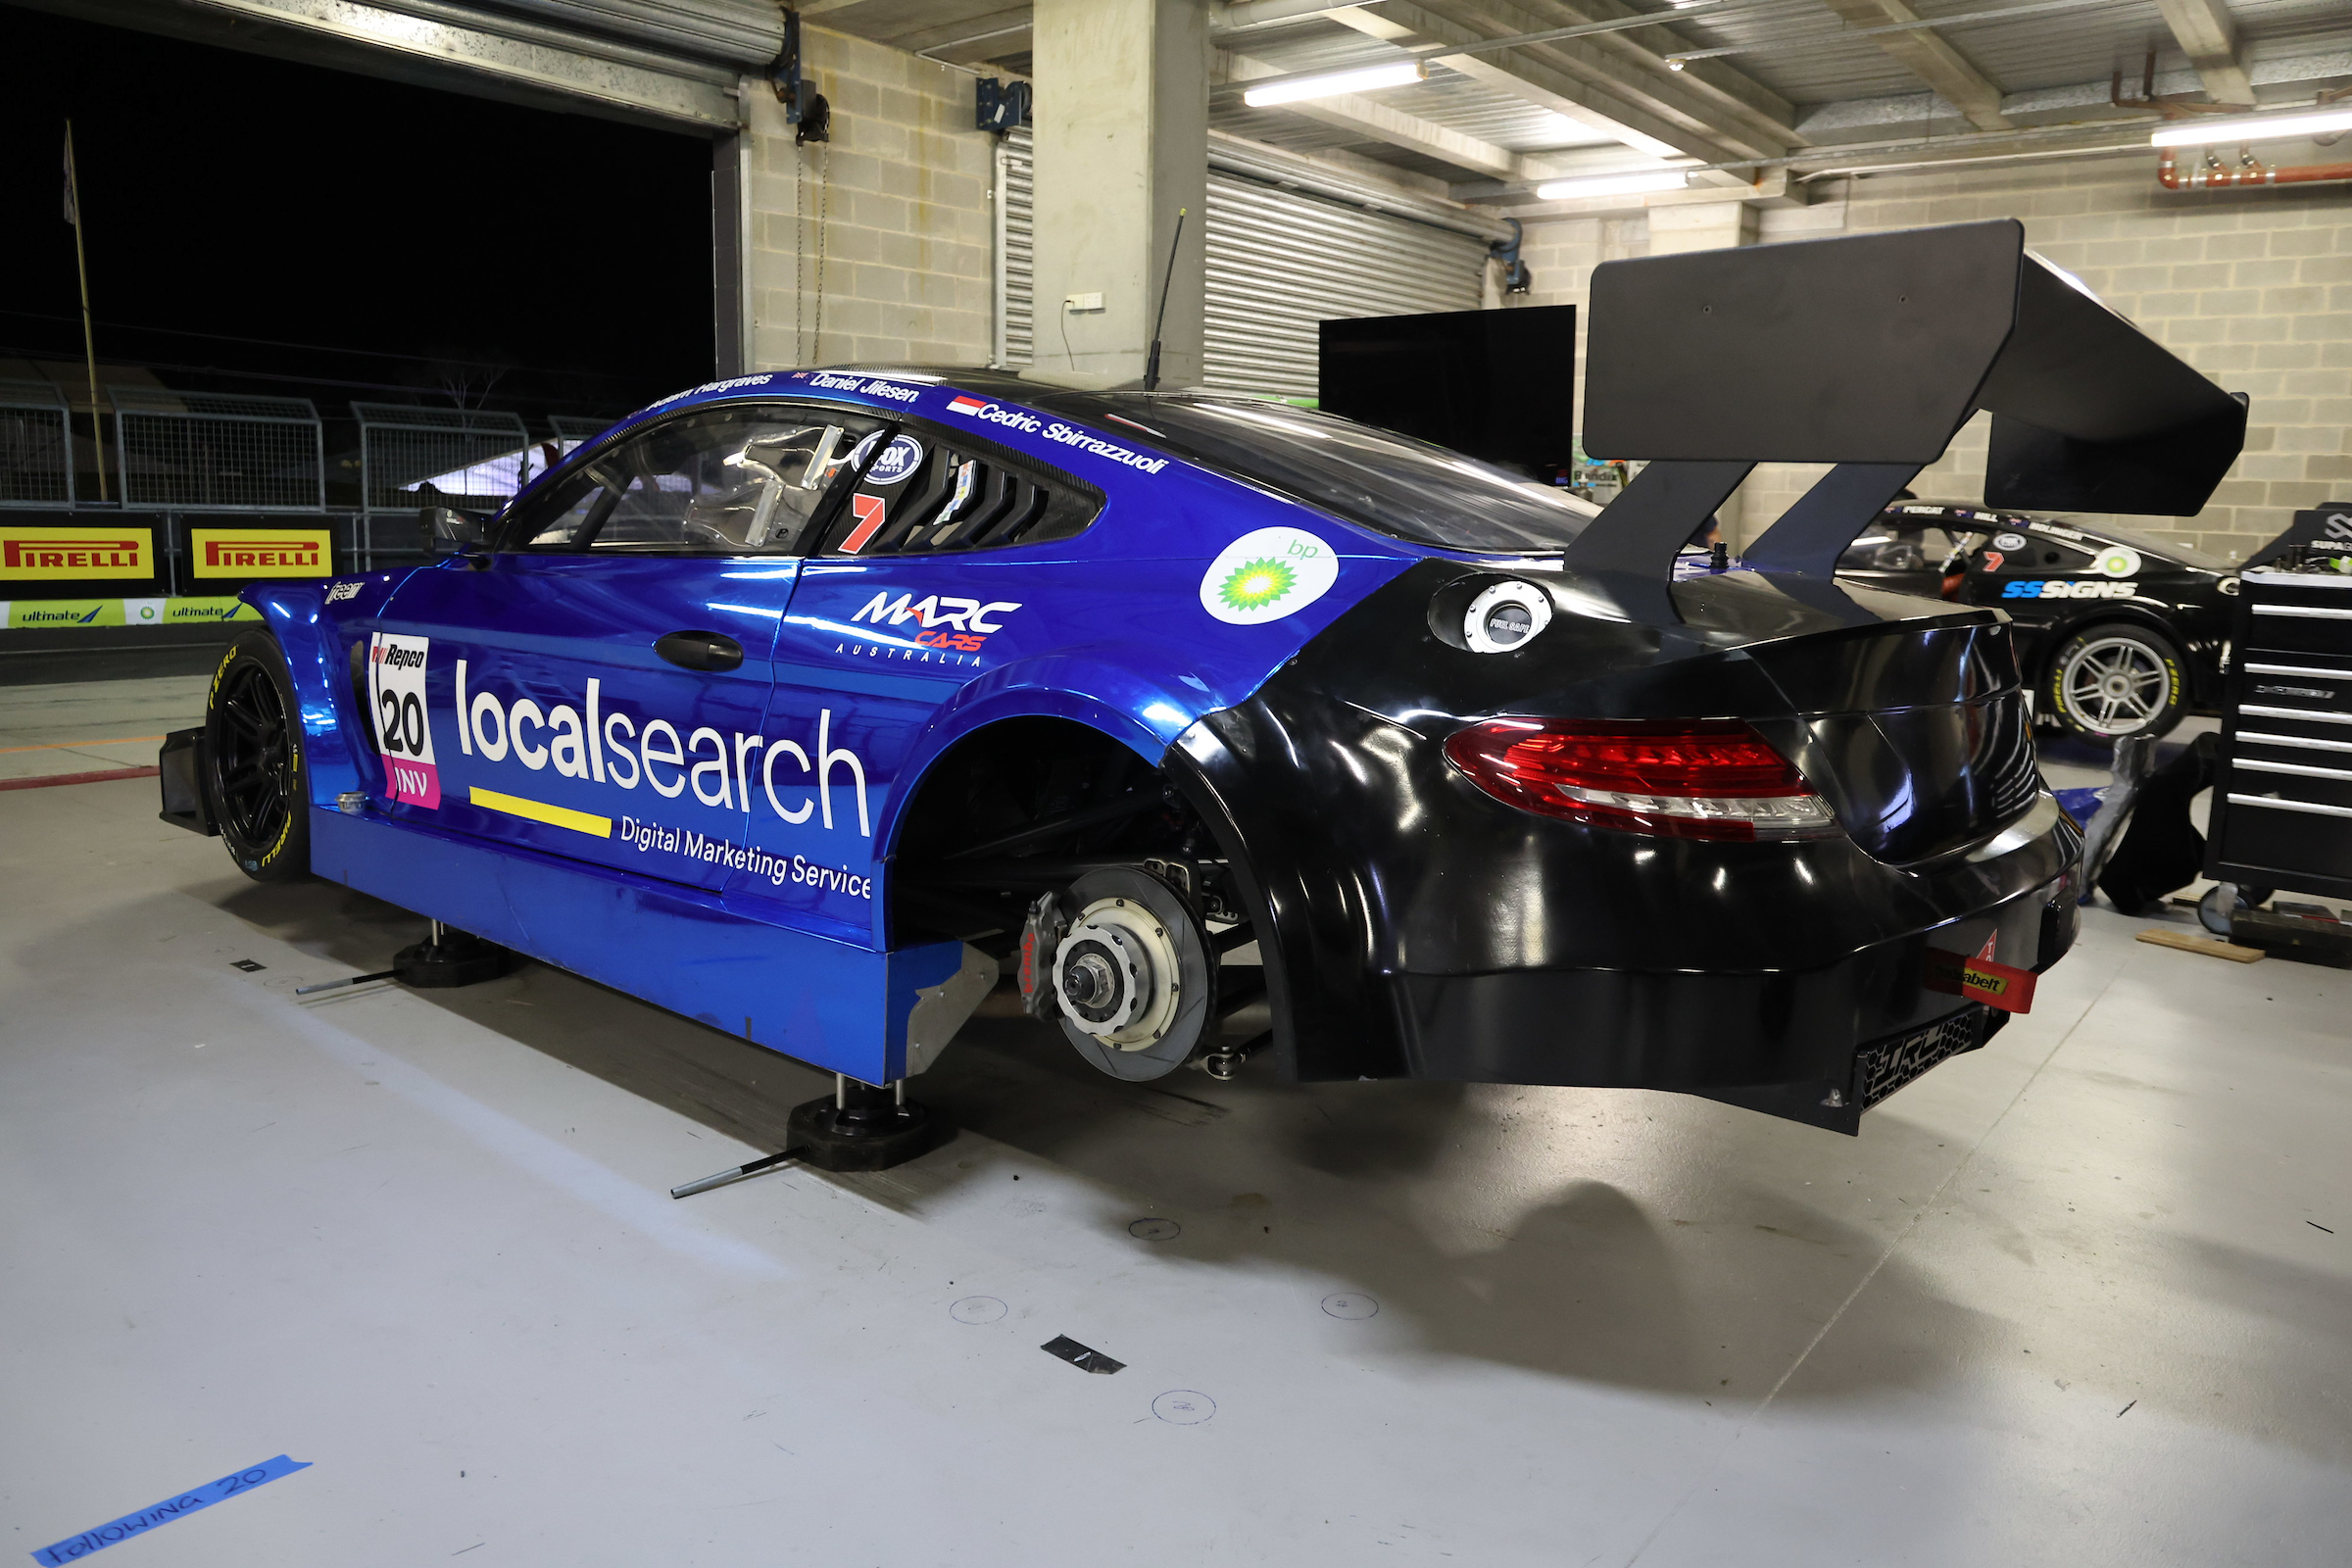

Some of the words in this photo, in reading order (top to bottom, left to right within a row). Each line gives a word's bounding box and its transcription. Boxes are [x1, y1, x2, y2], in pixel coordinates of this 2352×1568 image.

[645, 389, 694, 412] Adam
[694, 373, 774, 393] Hargraves
[808, 373, 861, 393] Daniel
[859, 379, 920, 404] Jilesen
[978, 403, 1042, 433] Cedric
[1042, 423, 1170, 475] Sbirrazzuoli
[837, 492, 886, 556] 7
[1973, 512, 1999, 523] HILL
[3, 540, 139, 567] PIRELLI
[205, 541, 319, 566] PIRELLI
[1287, 539, 1319, 561] bp
[1983, 551, 2005, 572] 7
[23, 610, 80, 622] ultimate
[172, 607, 223, 618] ultimate
[850, 591, 1023, 634] MARC
[1490, 617, 1509, 630] FUEL
[1509, 622, 1530, 634] SAFE
[914, 630, 988, 652] CARS
[385, 644, 424, 670] Repco
[835, 643, 981, 667] AUSTRALIA
[381, 689, 424, 757] 20
[455, 659, 871, 838] localsearch
[395, 766, 428, 798] INV
[620, 815, 681, 854] Digital
[684, 831, 788, 885] Marketing
[1023, 932, 1036, 994] brembo
[216, 1468, 267, 1495] 20
